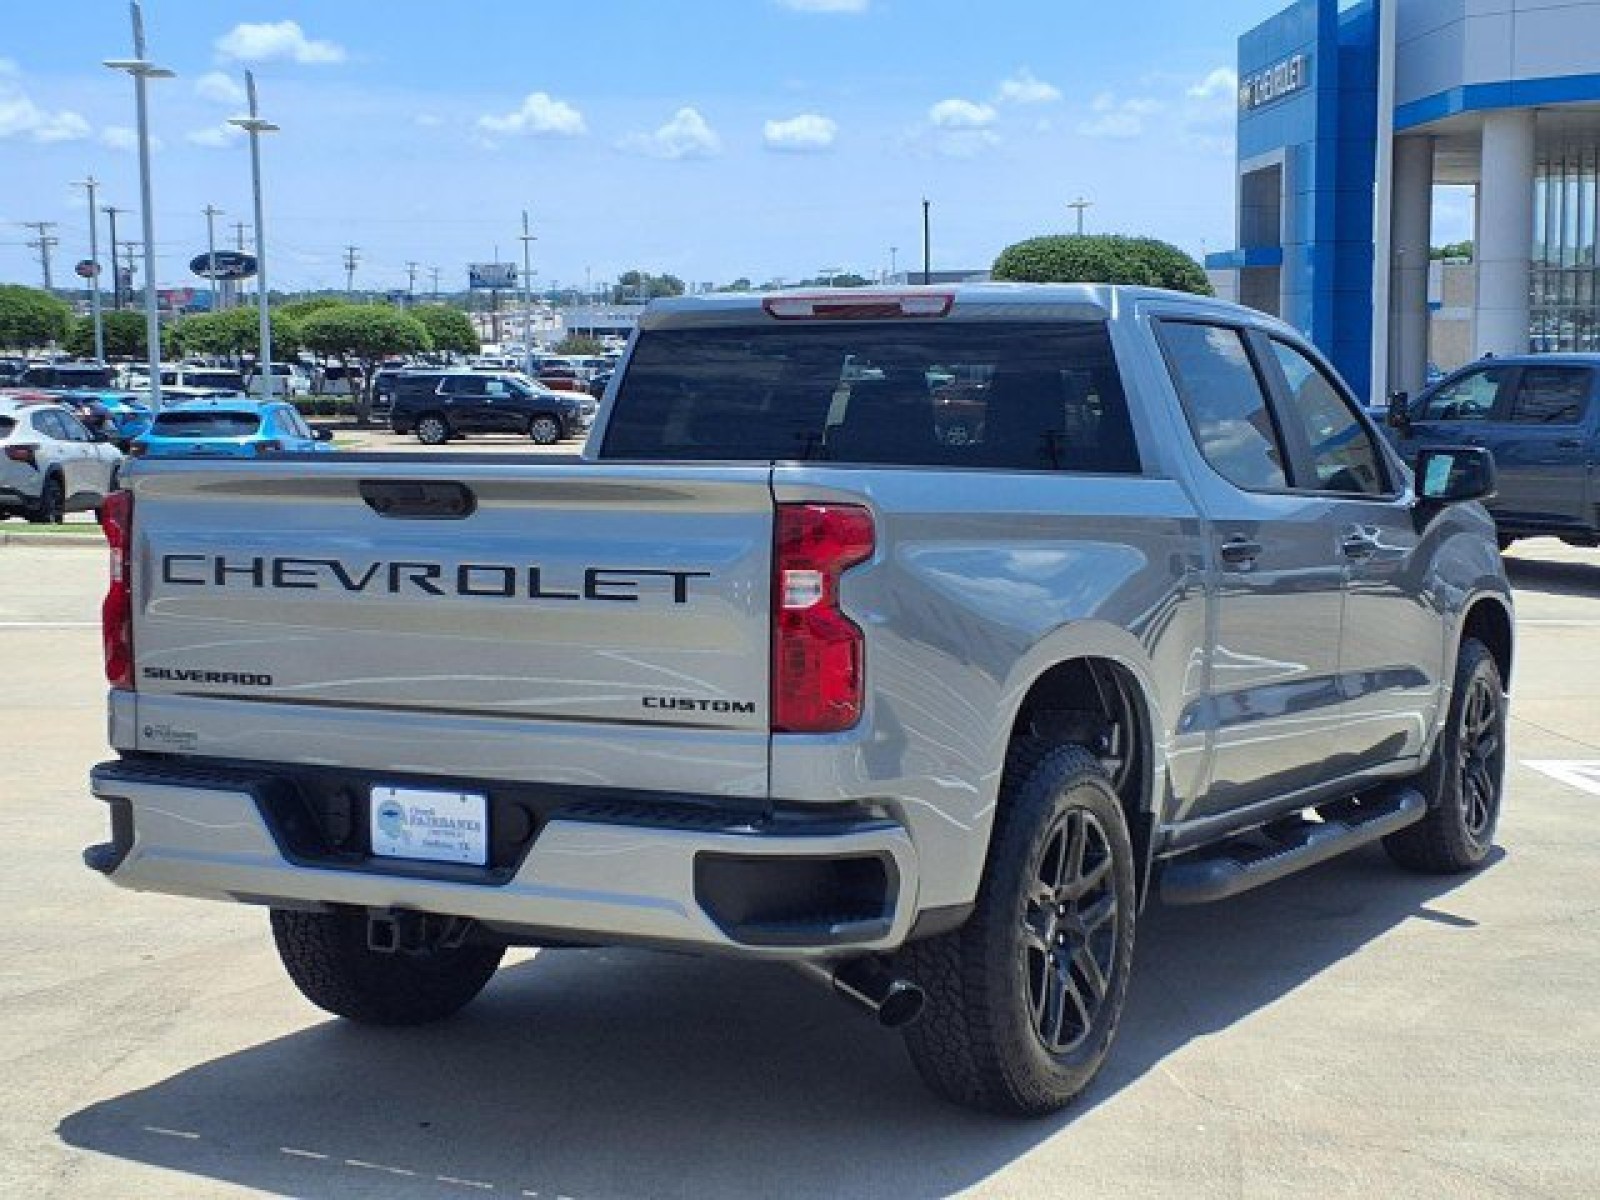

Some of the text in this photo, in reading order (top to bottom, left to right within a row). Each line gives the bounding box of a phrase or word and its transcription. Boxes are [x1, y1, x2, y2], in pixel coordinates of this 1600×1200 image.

[162, 554, 711, 604] CHEVROLET
[143, 667, 273, 686] SILVERADO
[642, 697, 756, 714] CUSTOM
